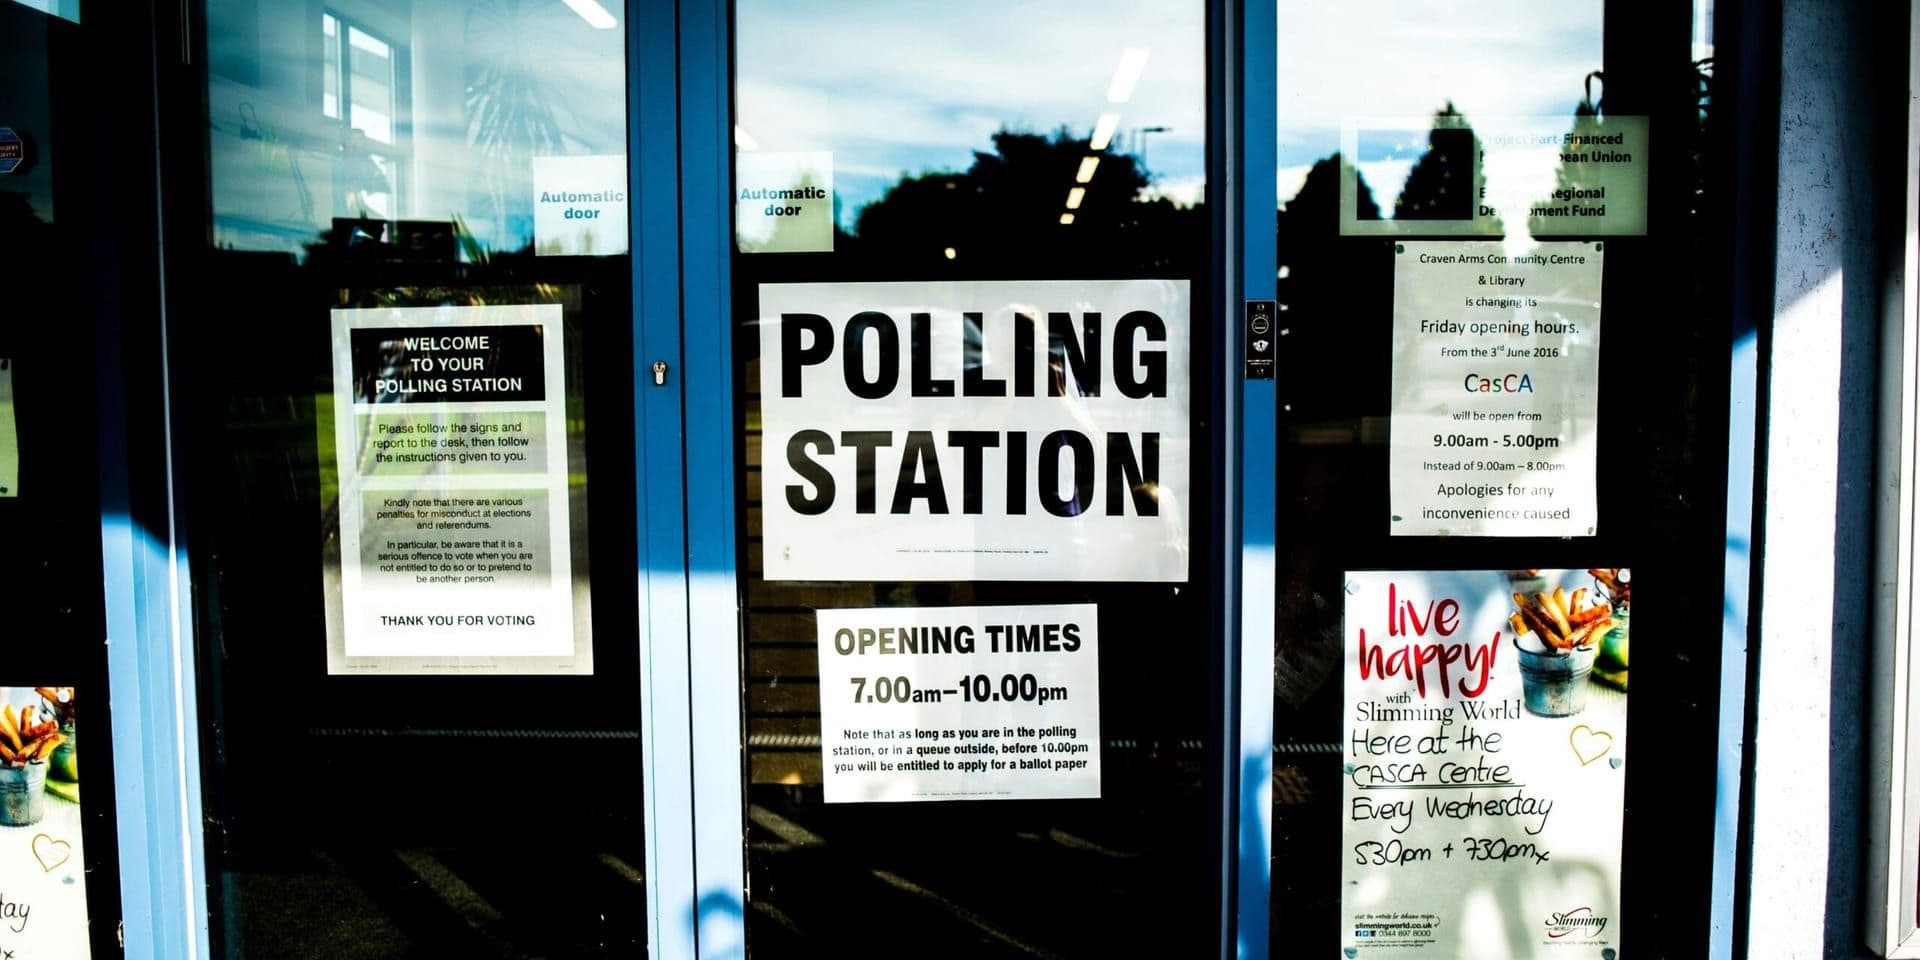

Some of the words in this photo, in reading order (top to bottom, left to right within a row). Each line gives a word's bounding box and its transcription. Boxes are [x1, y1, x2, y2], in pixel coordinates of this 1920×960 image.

[1532, 133, 1623, 144] Part-Financed
[1592, 151, 1631, 162] Union
[541, 190, 624, 203] Automatic
[741, 187, 825, 200] Automatic
[564, 208, 600, 219] door
[764, 204, 801, 216] door
[1572, 205, 1605, 217] Fund
[1420, 254, 1455, 264] Craven
[1458, 254, 1484, 264] Arms
[1550, 254, 1585, 264] Centre
[1490, 276, 1525, 287] Library
[1476, 297, 1522, 309] changing
[1421, 320, 1465, 336] Friday
[1471, 321, 1529, 336] opening
[1535, 320, 1579, 334] hours.
[405, 336, 489, 350] WELCOME
[781, 310, 1167, 399] POLLING
[1442, 348, 1468, 357] From
[1471, 348, 1488, 357] the
[1491, 345, 1504, 357] 3rd
[1506, 348, 1530, 357] June
[1534, 349, 1558, 357] 2016
[411, 359, 433, 372] TO
[438, 358, 484, 371] YOUR
[376, 379, 447, 394] POLLING
[452, 378, 522, 391] STATION
[1465, 374, 1533, 393] CasCA
[1453, 412, 1471, 421] will
[1474, 412, 1486, 421] be
[1489, 414, 1514, 423] open
[1517, 412, 1542, 421] from
[379, 423, 414, 434] Please
[417, 423, 448, 433] follow
[451, 423, 467, 433] the
[470, 423, 498, 435] signs
[502, 423, 521, 432] and
[373, 438, 404, 450] report
[407, 439, 417, 447] to
[420, 438, 437, 447] the
[441, 437, 468, 449] desk,
[471, 437, 495, 447] then
[498, 437, 529, 446] follow
[1434, 435, 1488, 447] 9.00am
[1503, 435, 1559, 449] 5.00pm
[376, 453, 392, 463] the
[396, 452, 456, 462] instructions
[459, 452, 487, 464] given
[490, 452, 501, 461] to
[504, 453, 526, 463] you.
[1424, 462, 1461, 471] Instead
[1464, 461, 1474, 471] of
[1477, 462, 1515, 471] 9.00am
[785, 429, 1160, 518] STATION
[1438, 484, 1503, 498] Apologies
[1508, 484, 1526, 496] for
[1530, 487, 1554, 498] any
[384, 499, 409, 508] Kindly
[413, 499, 431, 507] note
[492, 498, 523, 506] various
[377, 510, 415, 520] penalties
[417, 510, 428, 518] for
[431, 510, 480, 518] misconduct
[493, 509, 531, 517] elections
[1423, 508, 1519, 519] inconvenience
[1523, 507, 1570, 519] caused
[417, 521, 433, 529] and
[436, 521, 492, 529] referendums.
[387, 541, 395, 549] In
[398, 540, 438, 551] particular,
[441, 540, 452, 548] be
[483, 540, 498, 548] that
[378, 552, 409, 560] serious
[411, 552, 442, 560] offence
[476, 552, 499, 560] when
[501, 553, 517, 562] you
[380, 564, 394, 572] not
[396, 564, 427, 572] entitled
[440, 563, 452, 571] do
[489, 563, 521, 573] pretend
[417, 575, 427, 583] be
[430, 575, 461, 583] another
[464, 576, 496, 585] person.
[1389, 583, 1460, 637] live
[381, 616, 424, 625] THANK
[429, 616, 453, 625] YOU
[458, 615, 483, 625] FOR
[488, 615, 535, 625] VOTING
[835, 625, 975, 656] OPENING
[985, 623, 1081, 652] TIMES
[1359, 628, 1501, 699] happy!
[1386, 692, 1411, 703] with
[1356, 702, 1454, 725] Slimming
[1460, 700, 1521, 720] World
[844, 730, 868, 739] Note
[873, 729, 894, 739] that
[899, 731, 911, 739] as
[915, 728, 938, 741] long
[942, 730, 955, 738] as
[959, 730, 978, 741] you
[982, 729, 999, 738] are
[1003, 727, 1013, 738] in
[1017, 727, 1035, 737] the
[1038, 726, 1076, 739] polling
[1352, 729, 1411, 756] Here
[1418, 725, 1450, 754] at
[1456, 725, 1502, 754] the
[833, 745, 874, 757] station,
[878, 747, 889, 755] or
[892, 745, 902, 755] in
[916, 746, 950, 757] queue
[954, 743, 998, 755] outside,
[1002, 743, 1037, 753] before
[1042, 742, 1088, 755] 10.00pm
[835, 763, 853, 773] you
[858, 761, 876, 771] will
[881, 760, 893, 771] be
[897, 760, 940, 771] entitled
[944, 761, 954, 770] to
[958, 760, 987, 773] apply
[991, 759, 1006, 769] for
[1020, 759, 1051, 769] ballot
[1055, 760, 1087, 771] paper
[1352, 764, 1427, 786] CASCA
[1439, 756, 1512, 783] Centre
[1352, 797, 1414, 833] Every
[1427, 790, 1552, 834] Wednesday
[1545, 912, 1607, 937] Slimming
